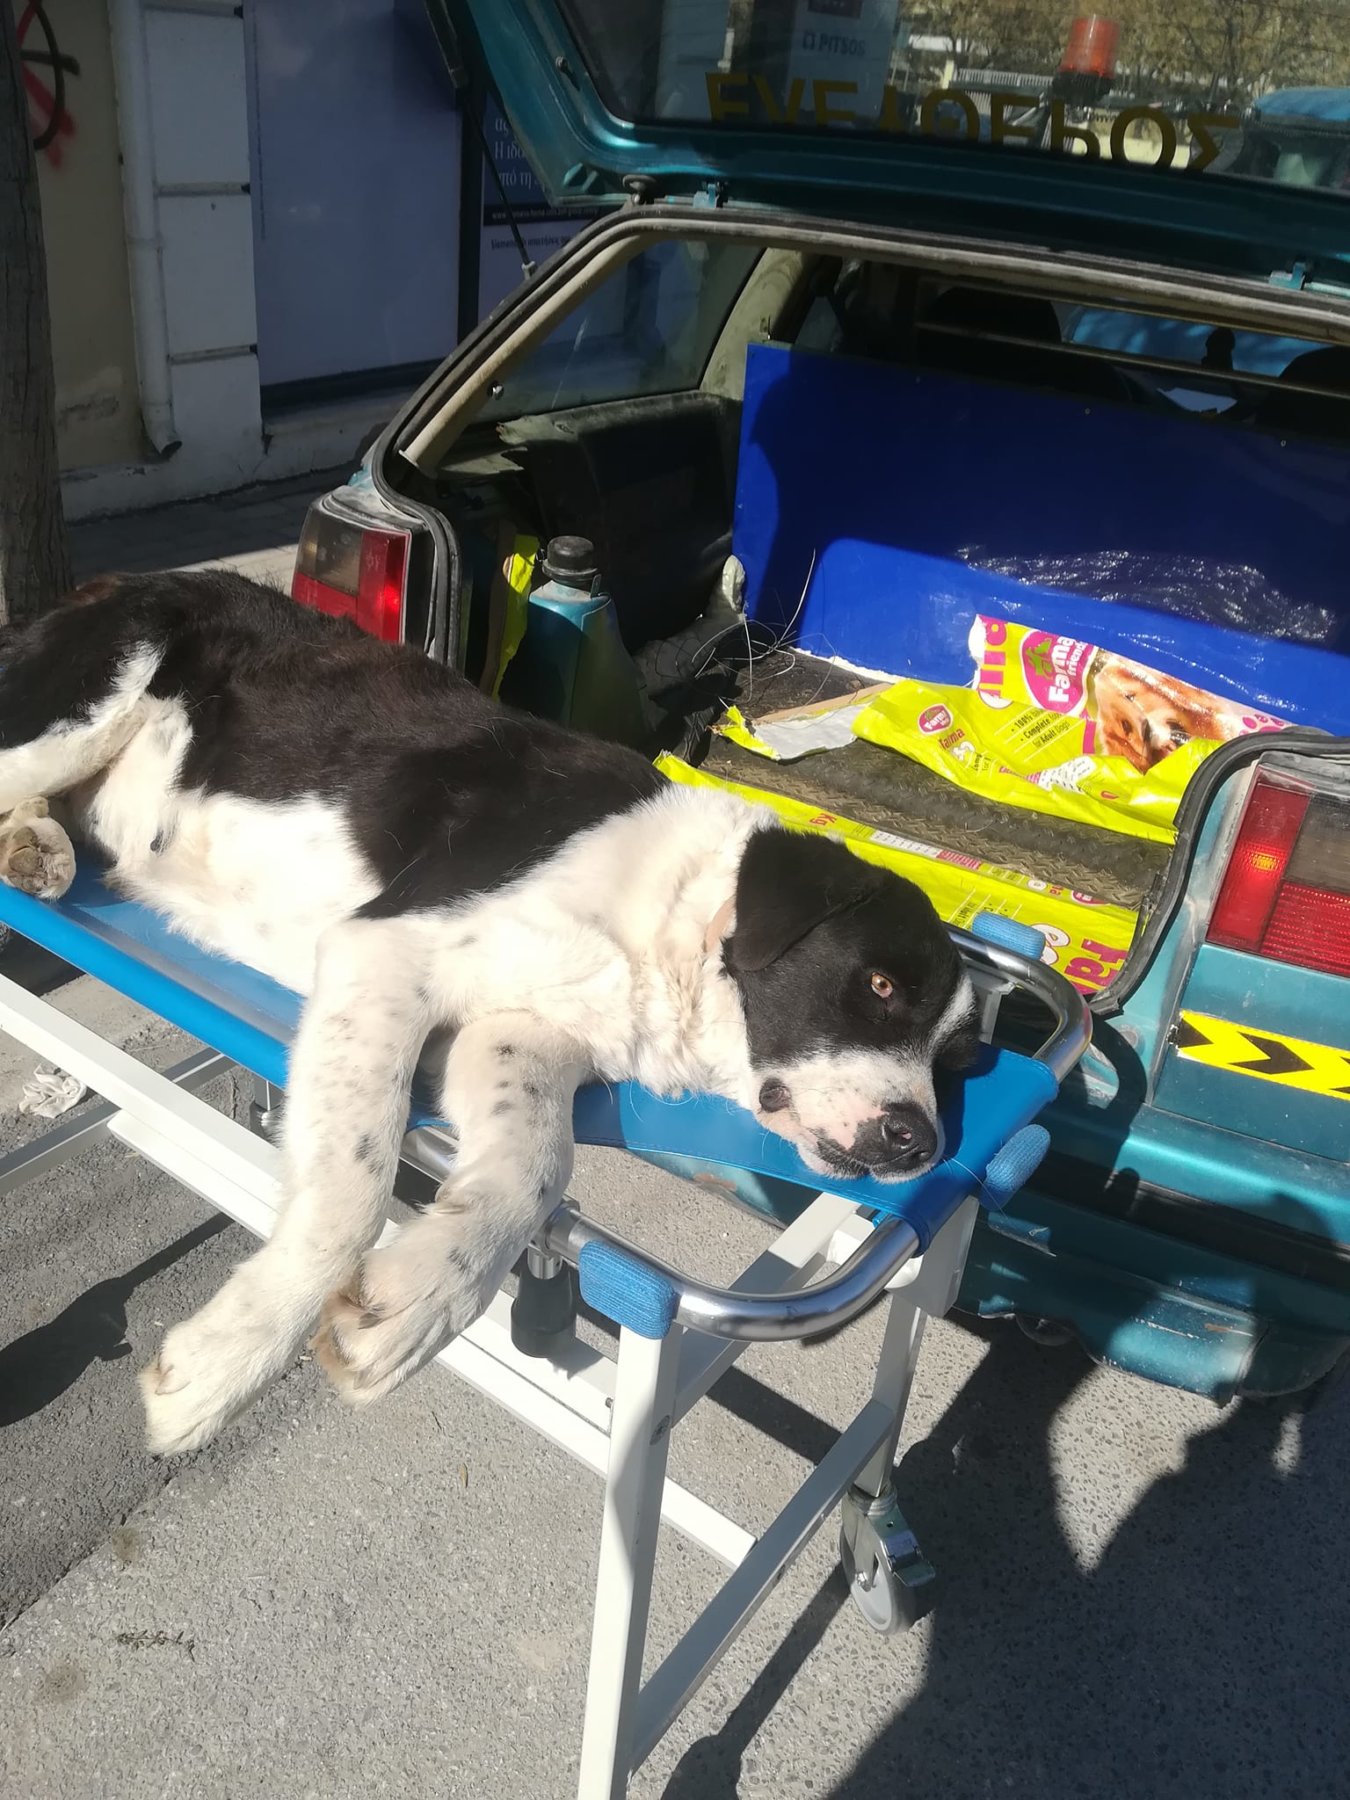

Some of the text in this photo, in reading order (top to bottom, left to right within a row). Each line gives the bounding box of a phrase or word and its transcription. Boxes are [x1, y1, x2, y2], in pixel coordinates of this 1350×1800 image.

[818, 32, 866, 56] PITSOS
[1048, 636, 1075, 703] Farma
[1023, 717, 1050, 740] Complete
[1041, 729, 1056, 745] Adult
